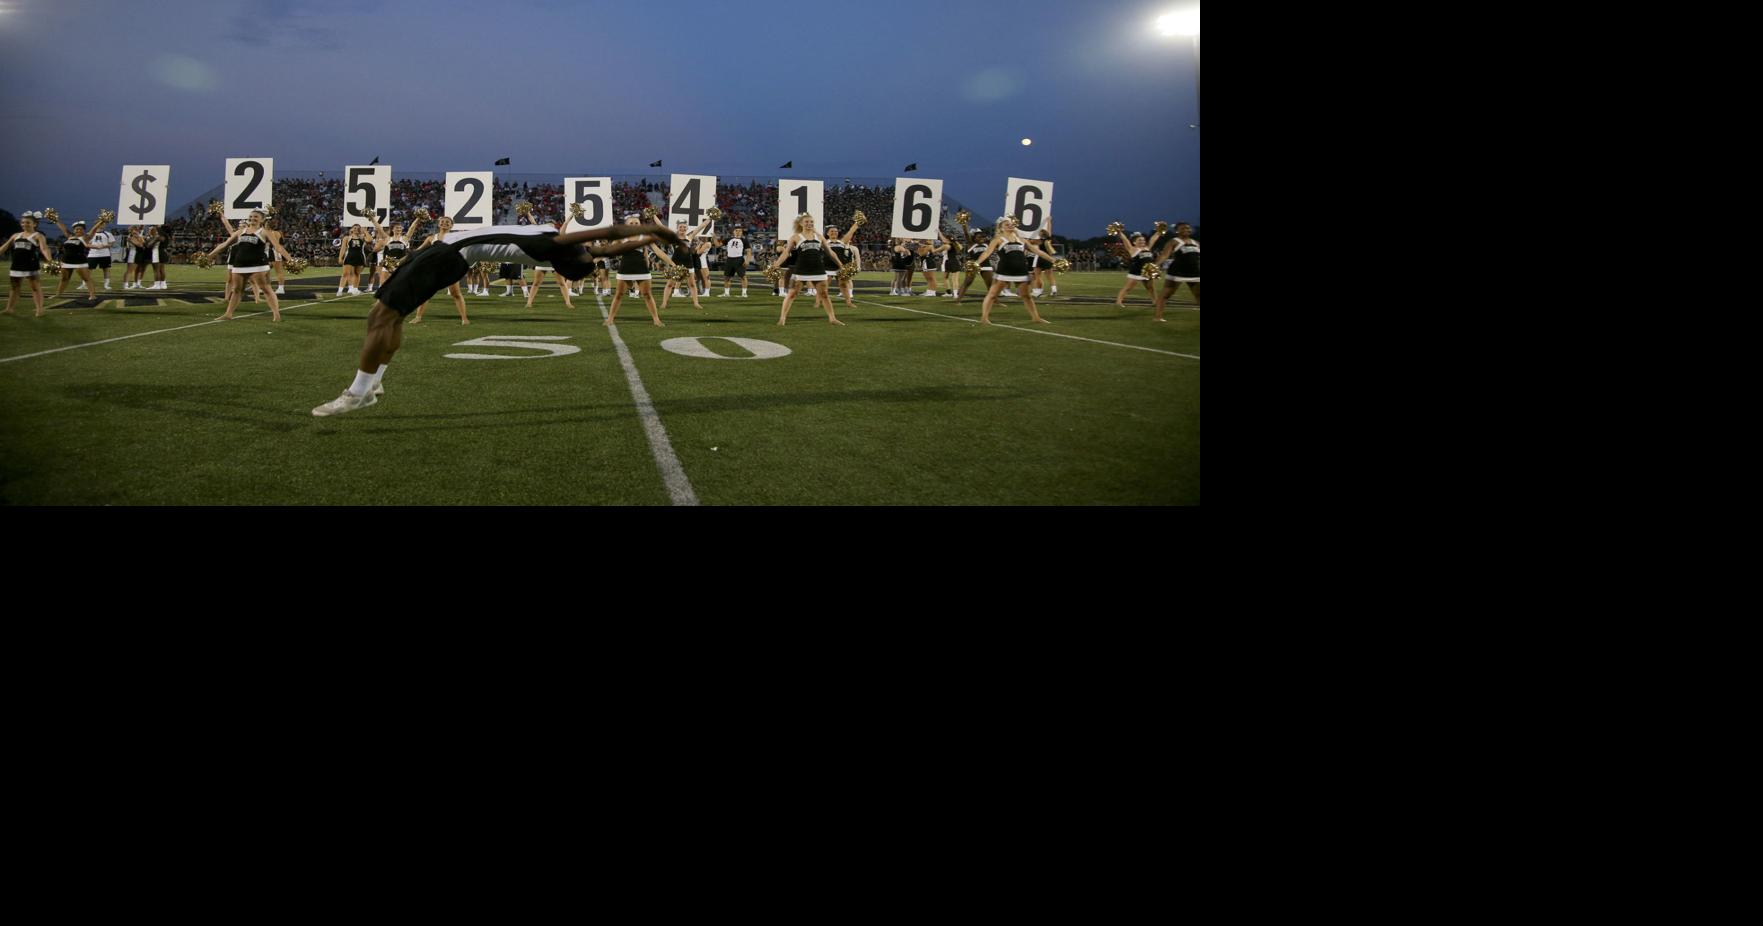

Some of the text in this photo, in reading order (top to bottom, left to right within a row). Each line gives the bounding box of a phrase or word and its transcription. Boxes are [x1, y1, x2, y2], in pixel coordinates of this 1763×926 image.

[129, 169, 157, 221] $
[232, 160, 265, 209] 2
[453, 177, 485, 224] 2
[574, 180, 604, 227] 5
[790, 185, 808, 215] 1
[902, 184, 933, 232] 6
[1013, 185, 1043, 232] 6
[442, 335, 581, 360] 5
